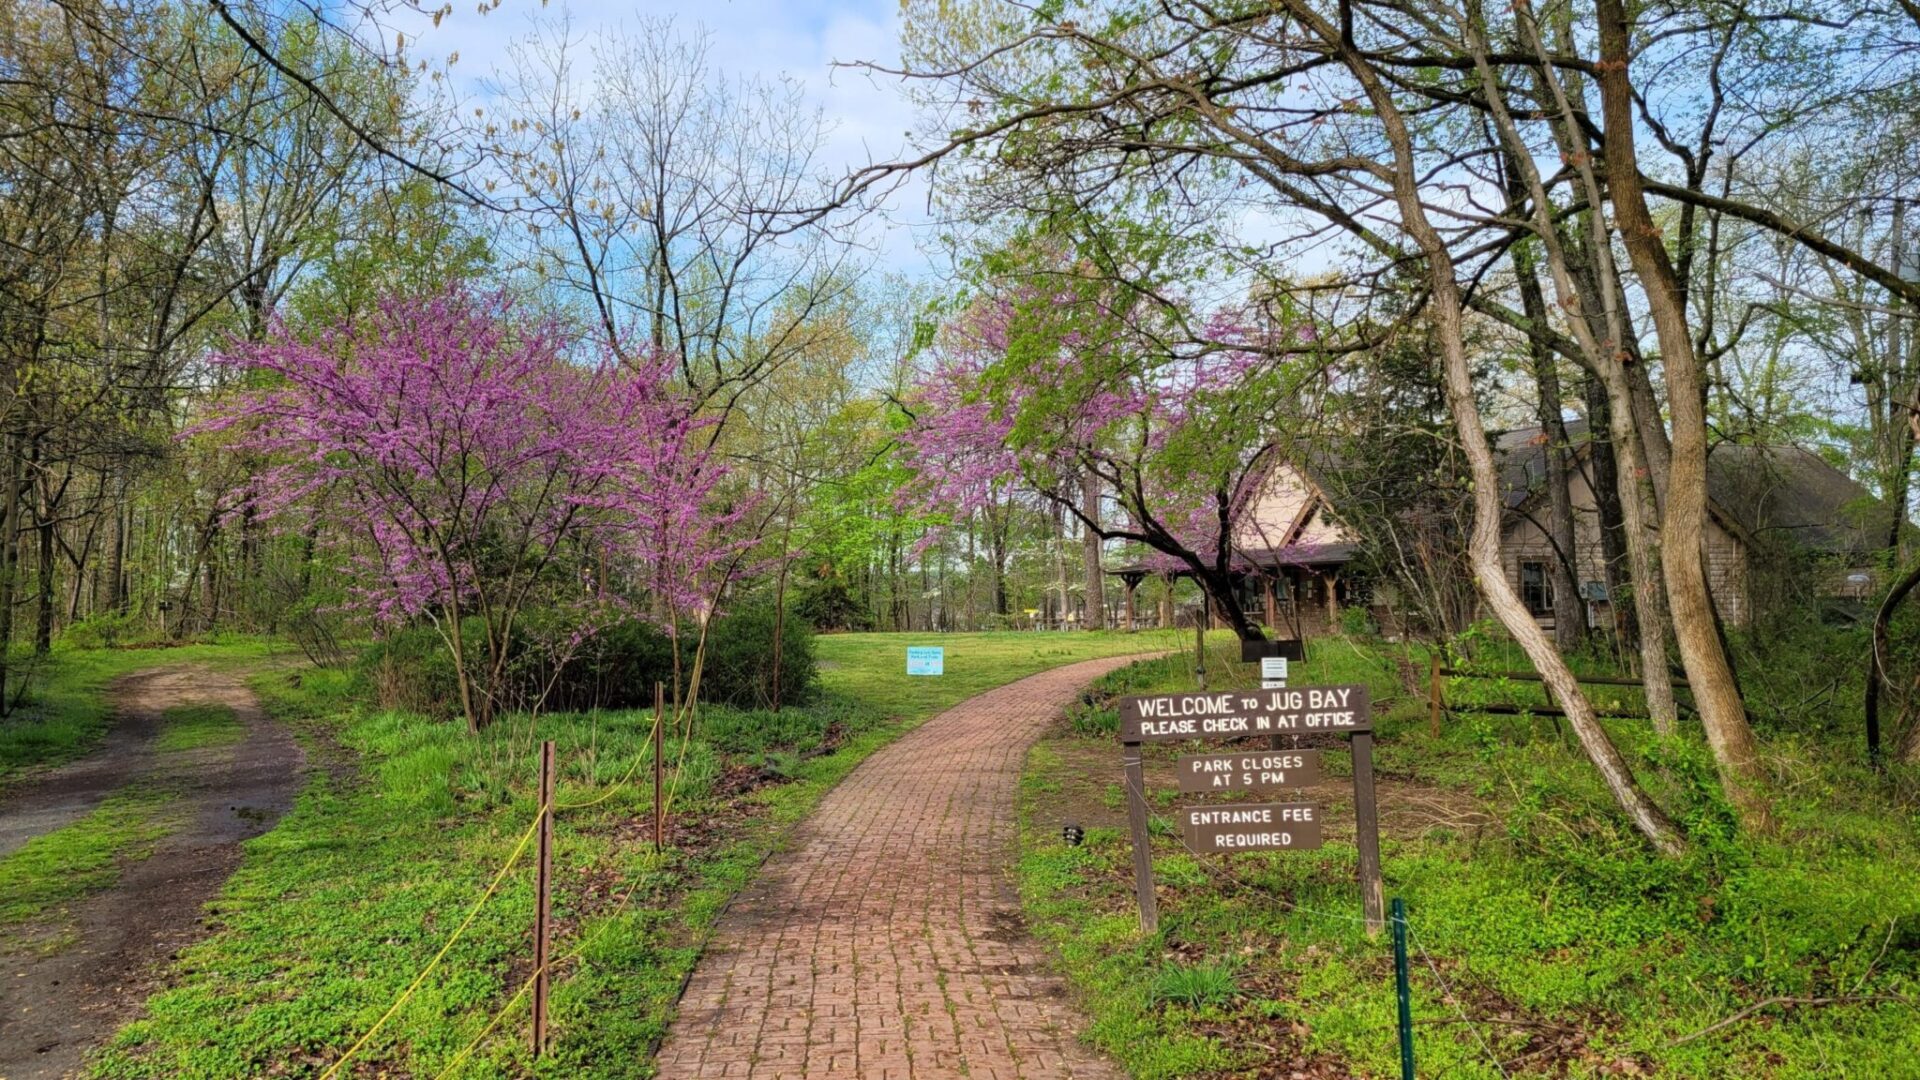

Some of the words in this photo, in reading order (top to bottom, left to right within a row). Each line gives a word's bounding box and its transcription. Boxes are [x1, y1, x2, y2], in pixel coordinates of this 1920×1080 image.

[1138, 695, 1235, 718] WELCOME
[1241, 698, 1258, 710] TO
[1266, 692, 1303, 711] JUG
[1309, 689, 1351, 709] BAY
[1141, 720, 1197, 735] PLEASE
[1203, 717, 1249, 732] CHECK
[1257, 716, 1270, 730] IN
[1278, 715, 1299, 728] AT
[1305, 712, 1355, 727] OFFICE
[1192, 759, 1233, 772] PARK
[1242, 756, 1303, 770] CLOSES
[1213, 774, 1231, 786] AT
[1243, 774, 1253, 785] 5
[1261, 772, 1284, 784] PM
[1190, 810, 1272, 825] ENTRANCE
[1283, 808, 1313, 822] FEE
[1215, 833, 1291, 847] REQUIRED
